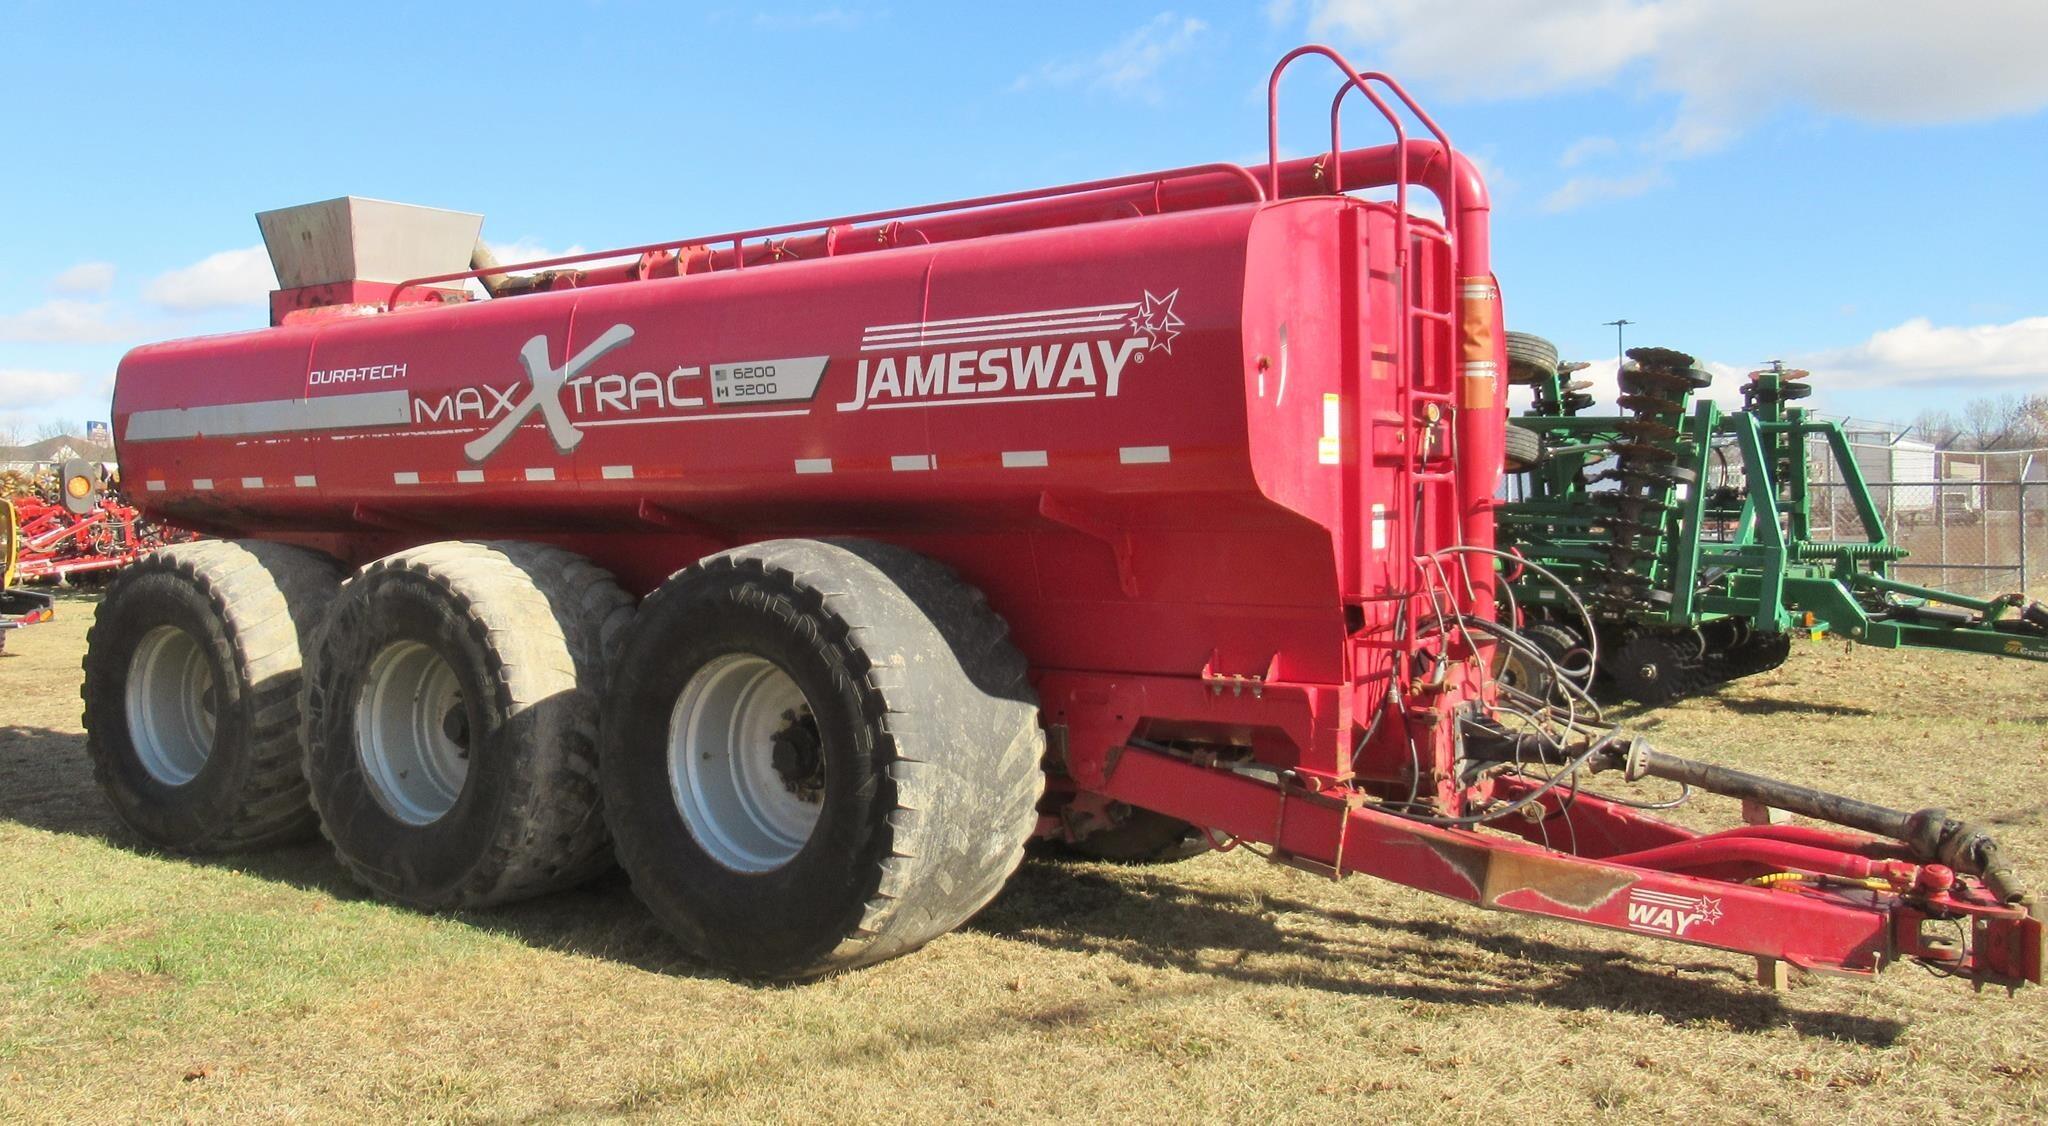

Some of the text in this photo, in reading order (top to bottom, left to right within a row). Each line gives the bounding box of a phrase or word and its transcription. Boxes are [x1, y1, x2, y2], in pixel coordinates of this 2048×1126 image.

[309, 363, 407, 385] DURA-TECH
[733, 366, 776, 379] 6200
[836, 336, 1149, 412] JAMESWAY
[735, 383, 777, 396] 5200
[1628, 903, 1704, 936] WAY
